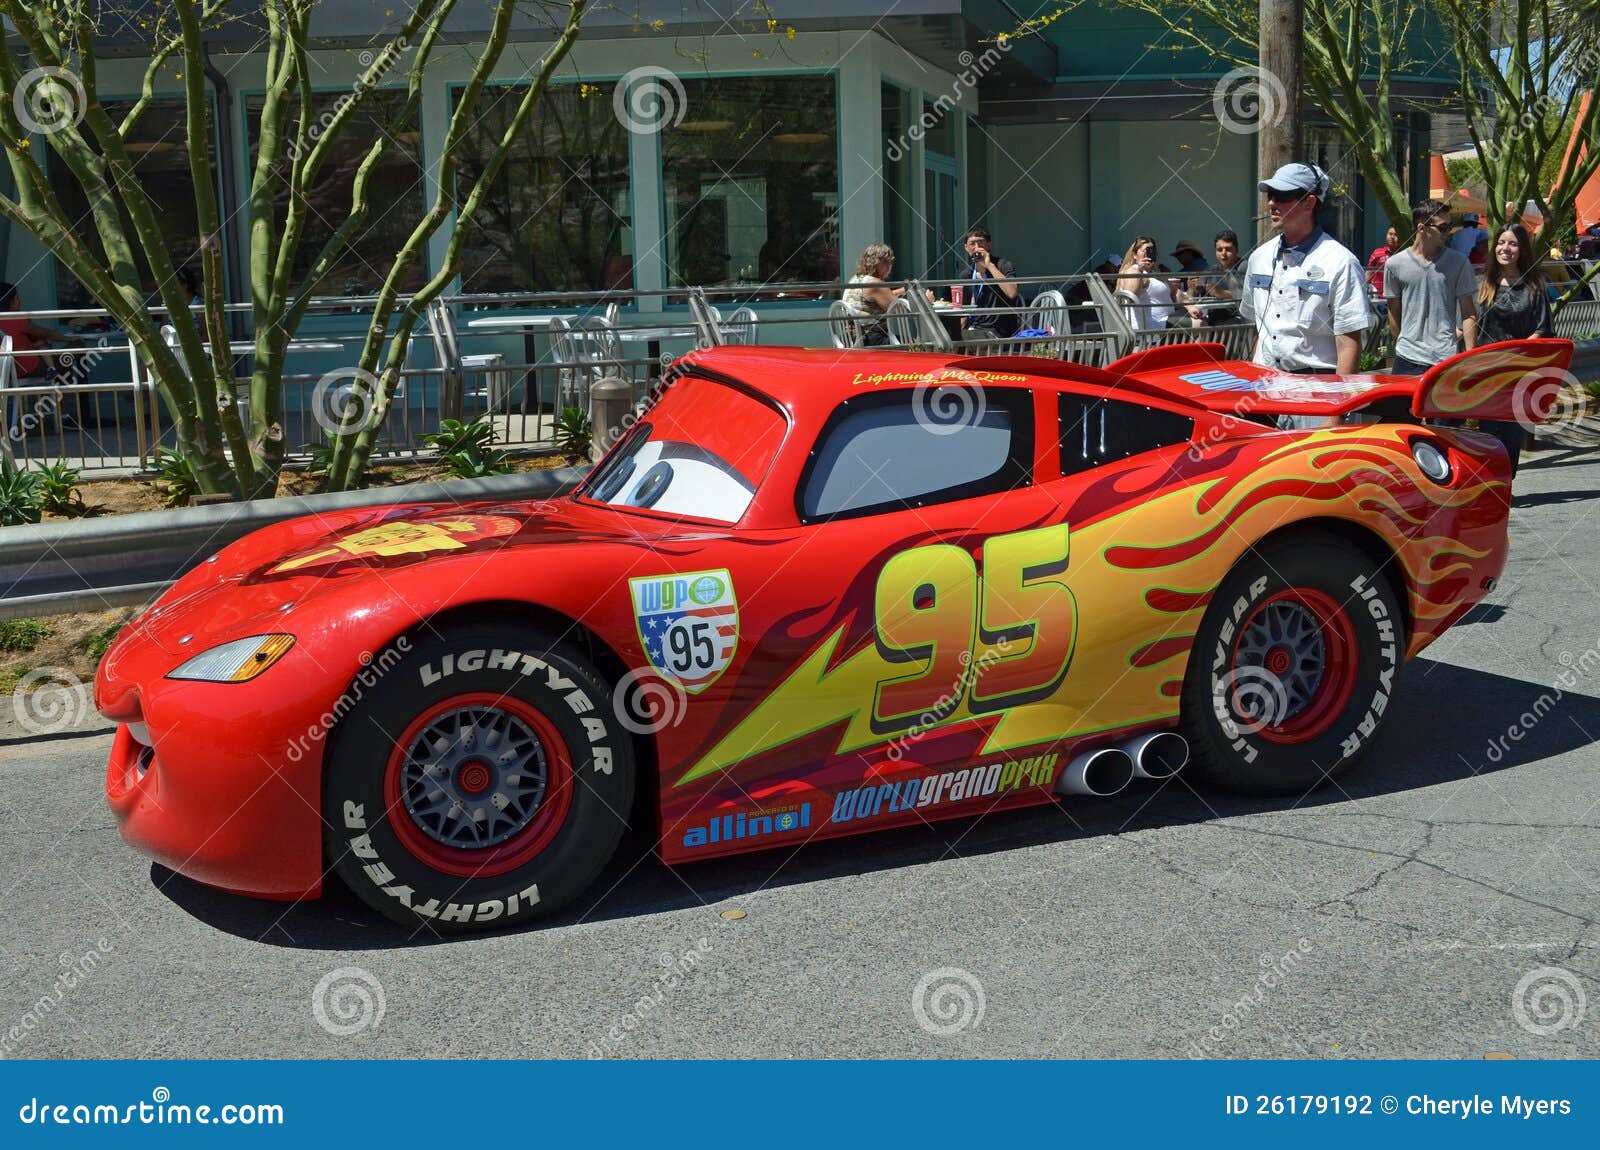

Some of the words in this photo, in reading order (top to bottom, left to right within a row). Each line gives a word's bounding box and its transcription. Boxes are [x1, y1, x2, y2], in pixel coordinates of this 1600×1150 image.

[852, 371, 938, 386] Lightning
[669, 622, 715, 672] 95
[870, 522, 1078, 735] 95
[1211, 575, 1268, 764] LIGHTYEAR
[1339, 574, 1396, 758] LIGHTYEAR
[419, 648, 613, 776] LIGHTYEAR
[343, 799, 542, 923] LIGHTYEAR
[683, 802, 812, 847] allinol
